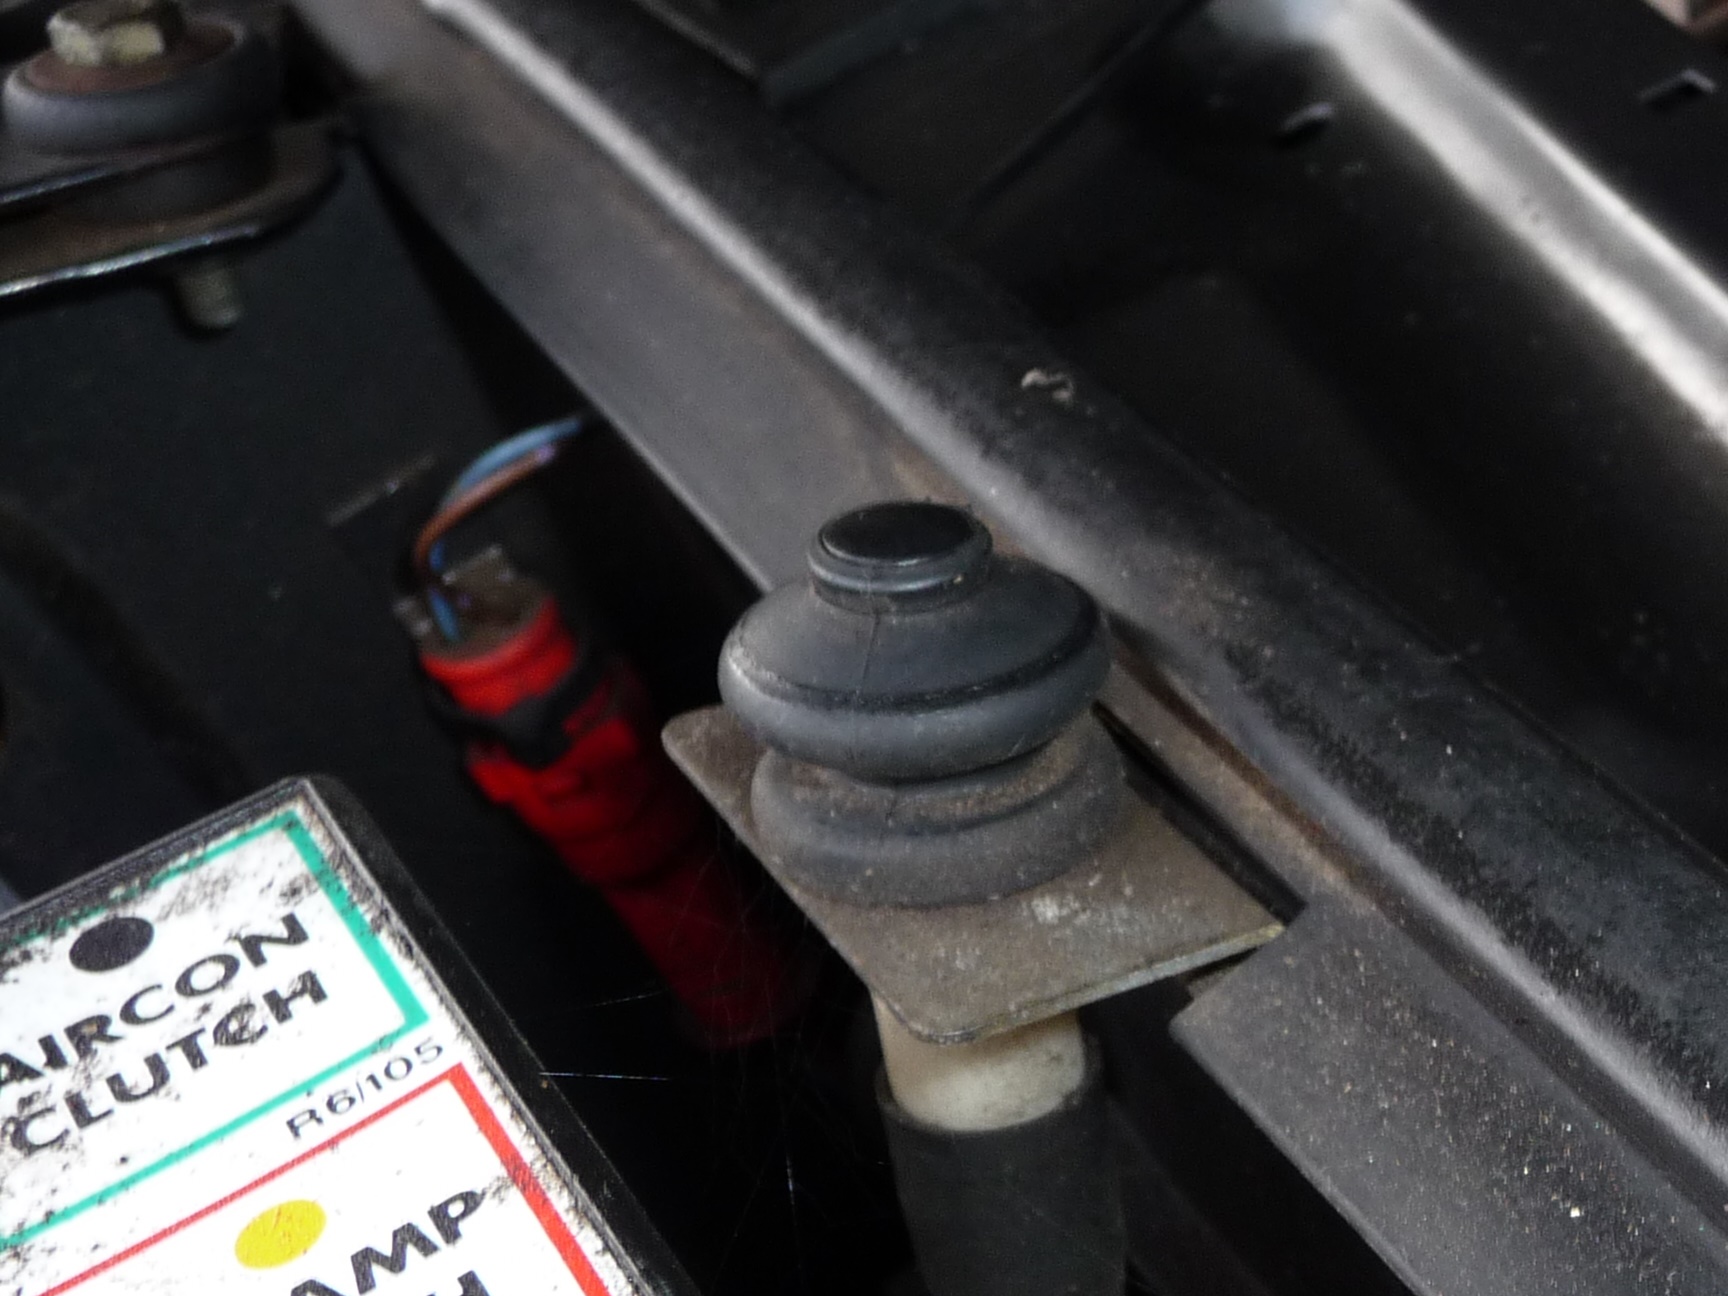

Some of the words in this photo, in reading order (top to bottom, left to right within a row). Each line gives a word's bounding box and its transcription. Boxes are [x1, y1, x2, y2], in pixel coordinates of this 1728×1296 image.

[0, 912, 309, 1087] AIRCON
[9, 970, 328, 1154] CLUTCH
[286, 1036, 443, 1140] R6/105
